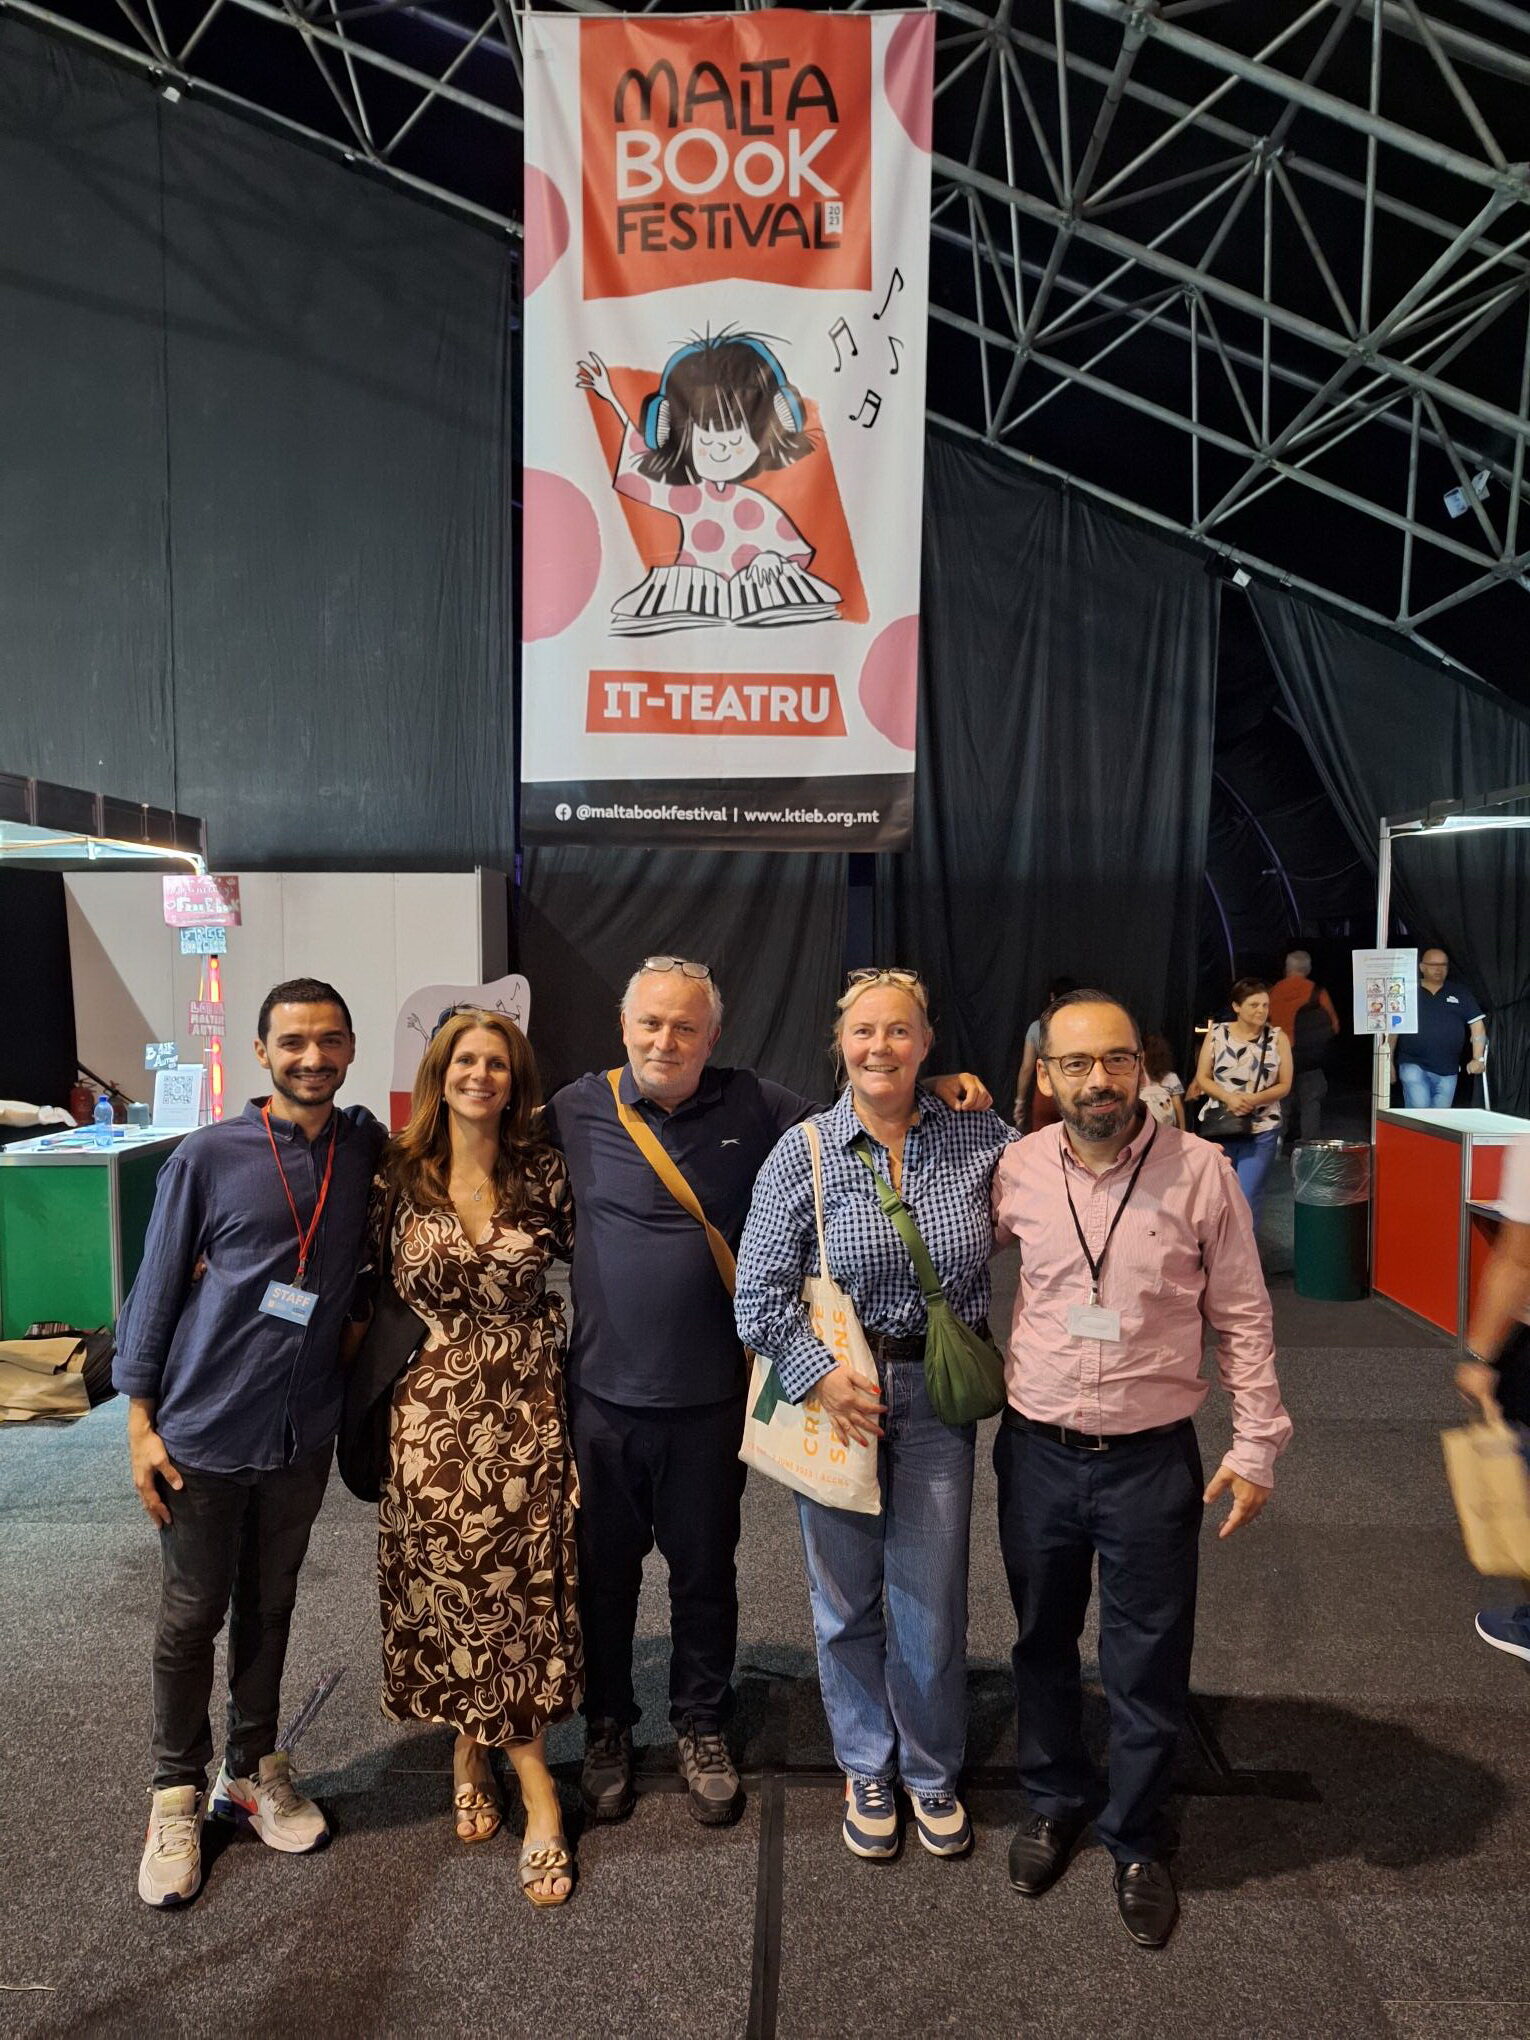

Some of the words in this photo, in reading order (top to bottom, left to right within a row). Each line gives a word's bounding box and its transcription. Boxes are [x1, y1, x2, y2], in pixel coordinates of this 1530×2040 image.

[614, 58, 840, 136] MALTA
[615, 128, 840, 201] BOOK
[617, 202, 841, 255] FESTIVAL
[829, 206, 840, 215] 20
[603, 682, 830, 724] IT-TEATRU
[576, 805, 727, 823] @maltabookfestival
[744, 807, 880, 828] www.ktieb.org.mt
[272, 1287, 311, 1307] STAFF
